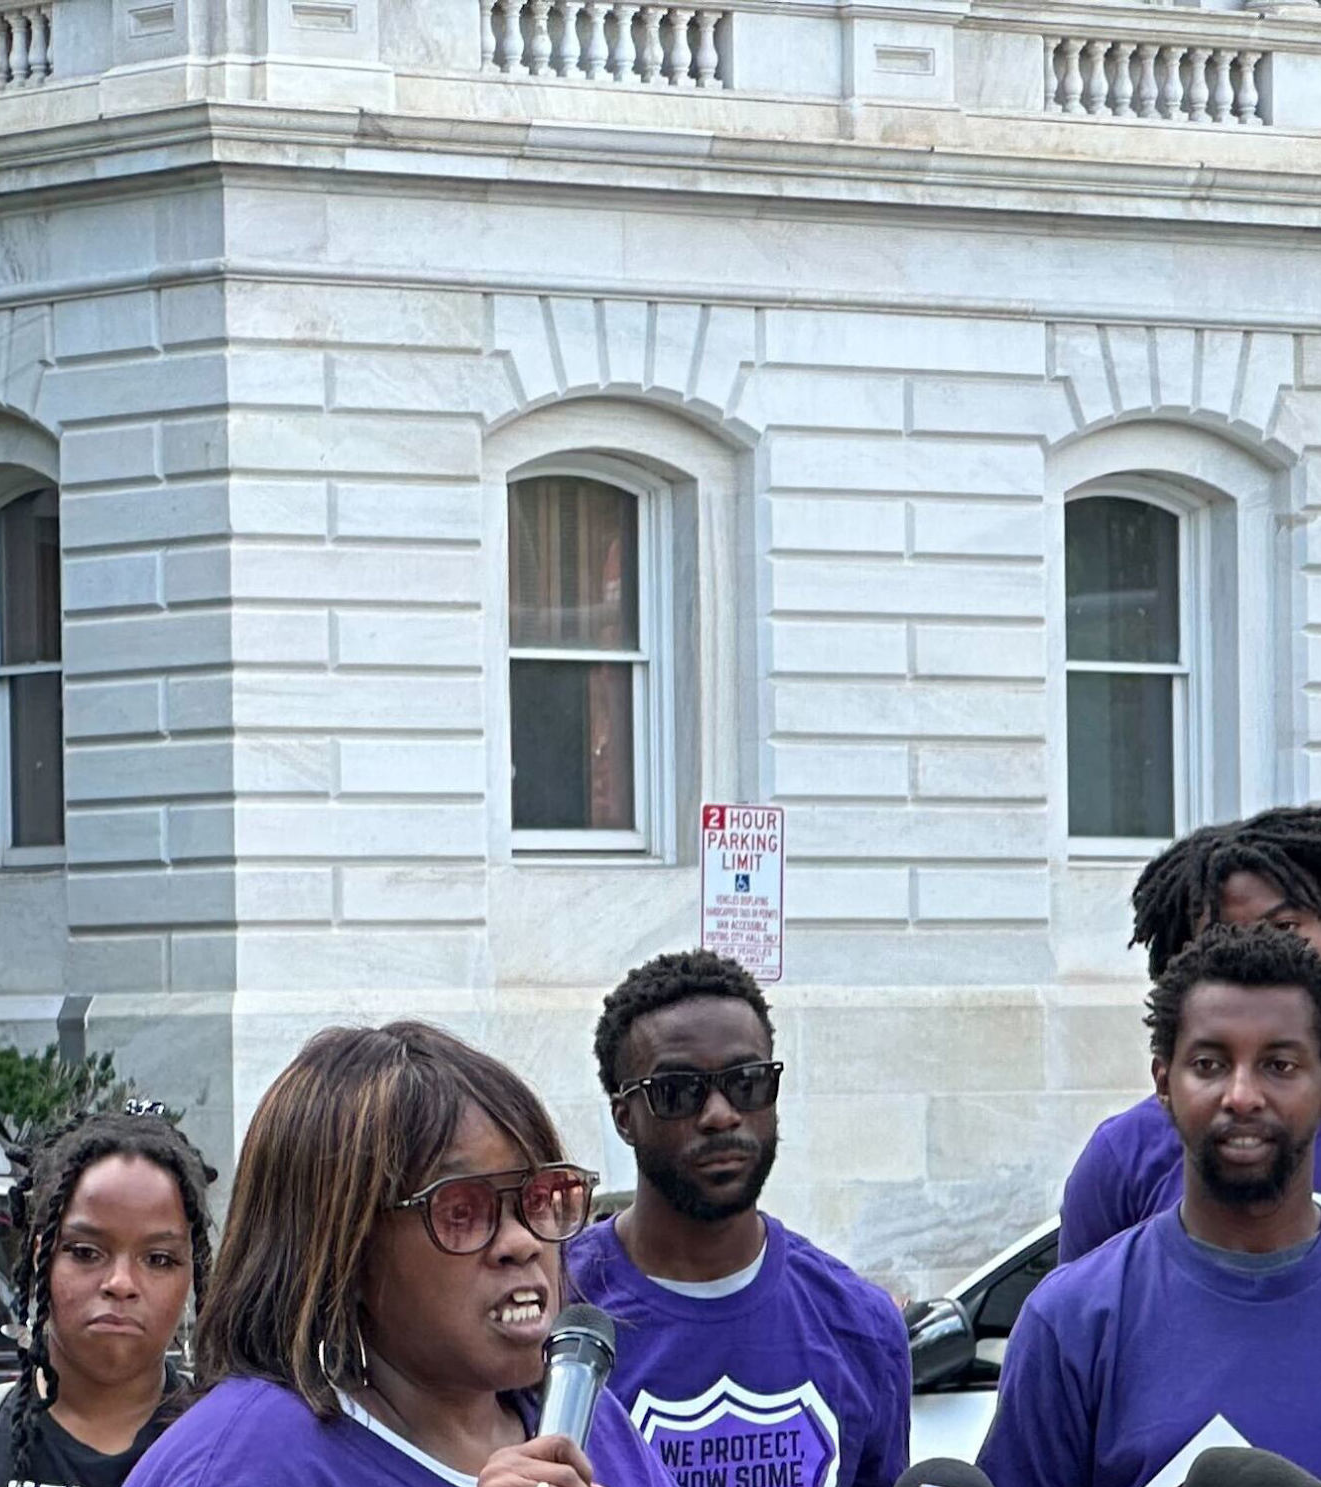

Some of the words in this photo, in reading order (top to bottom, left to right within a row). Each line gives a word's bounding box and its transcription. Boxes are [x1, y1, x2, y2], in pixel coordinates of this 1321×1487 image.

[708, 809, 720, 827] 2
[730, 811, 777, 830] HOUR
[707, 832, 778, 853] PARKING
[722, 854, 763, 871] LIMIT
[660, 1440, 694, 1467] WE
[700, 1430, 806, 1466] PROTECT,
